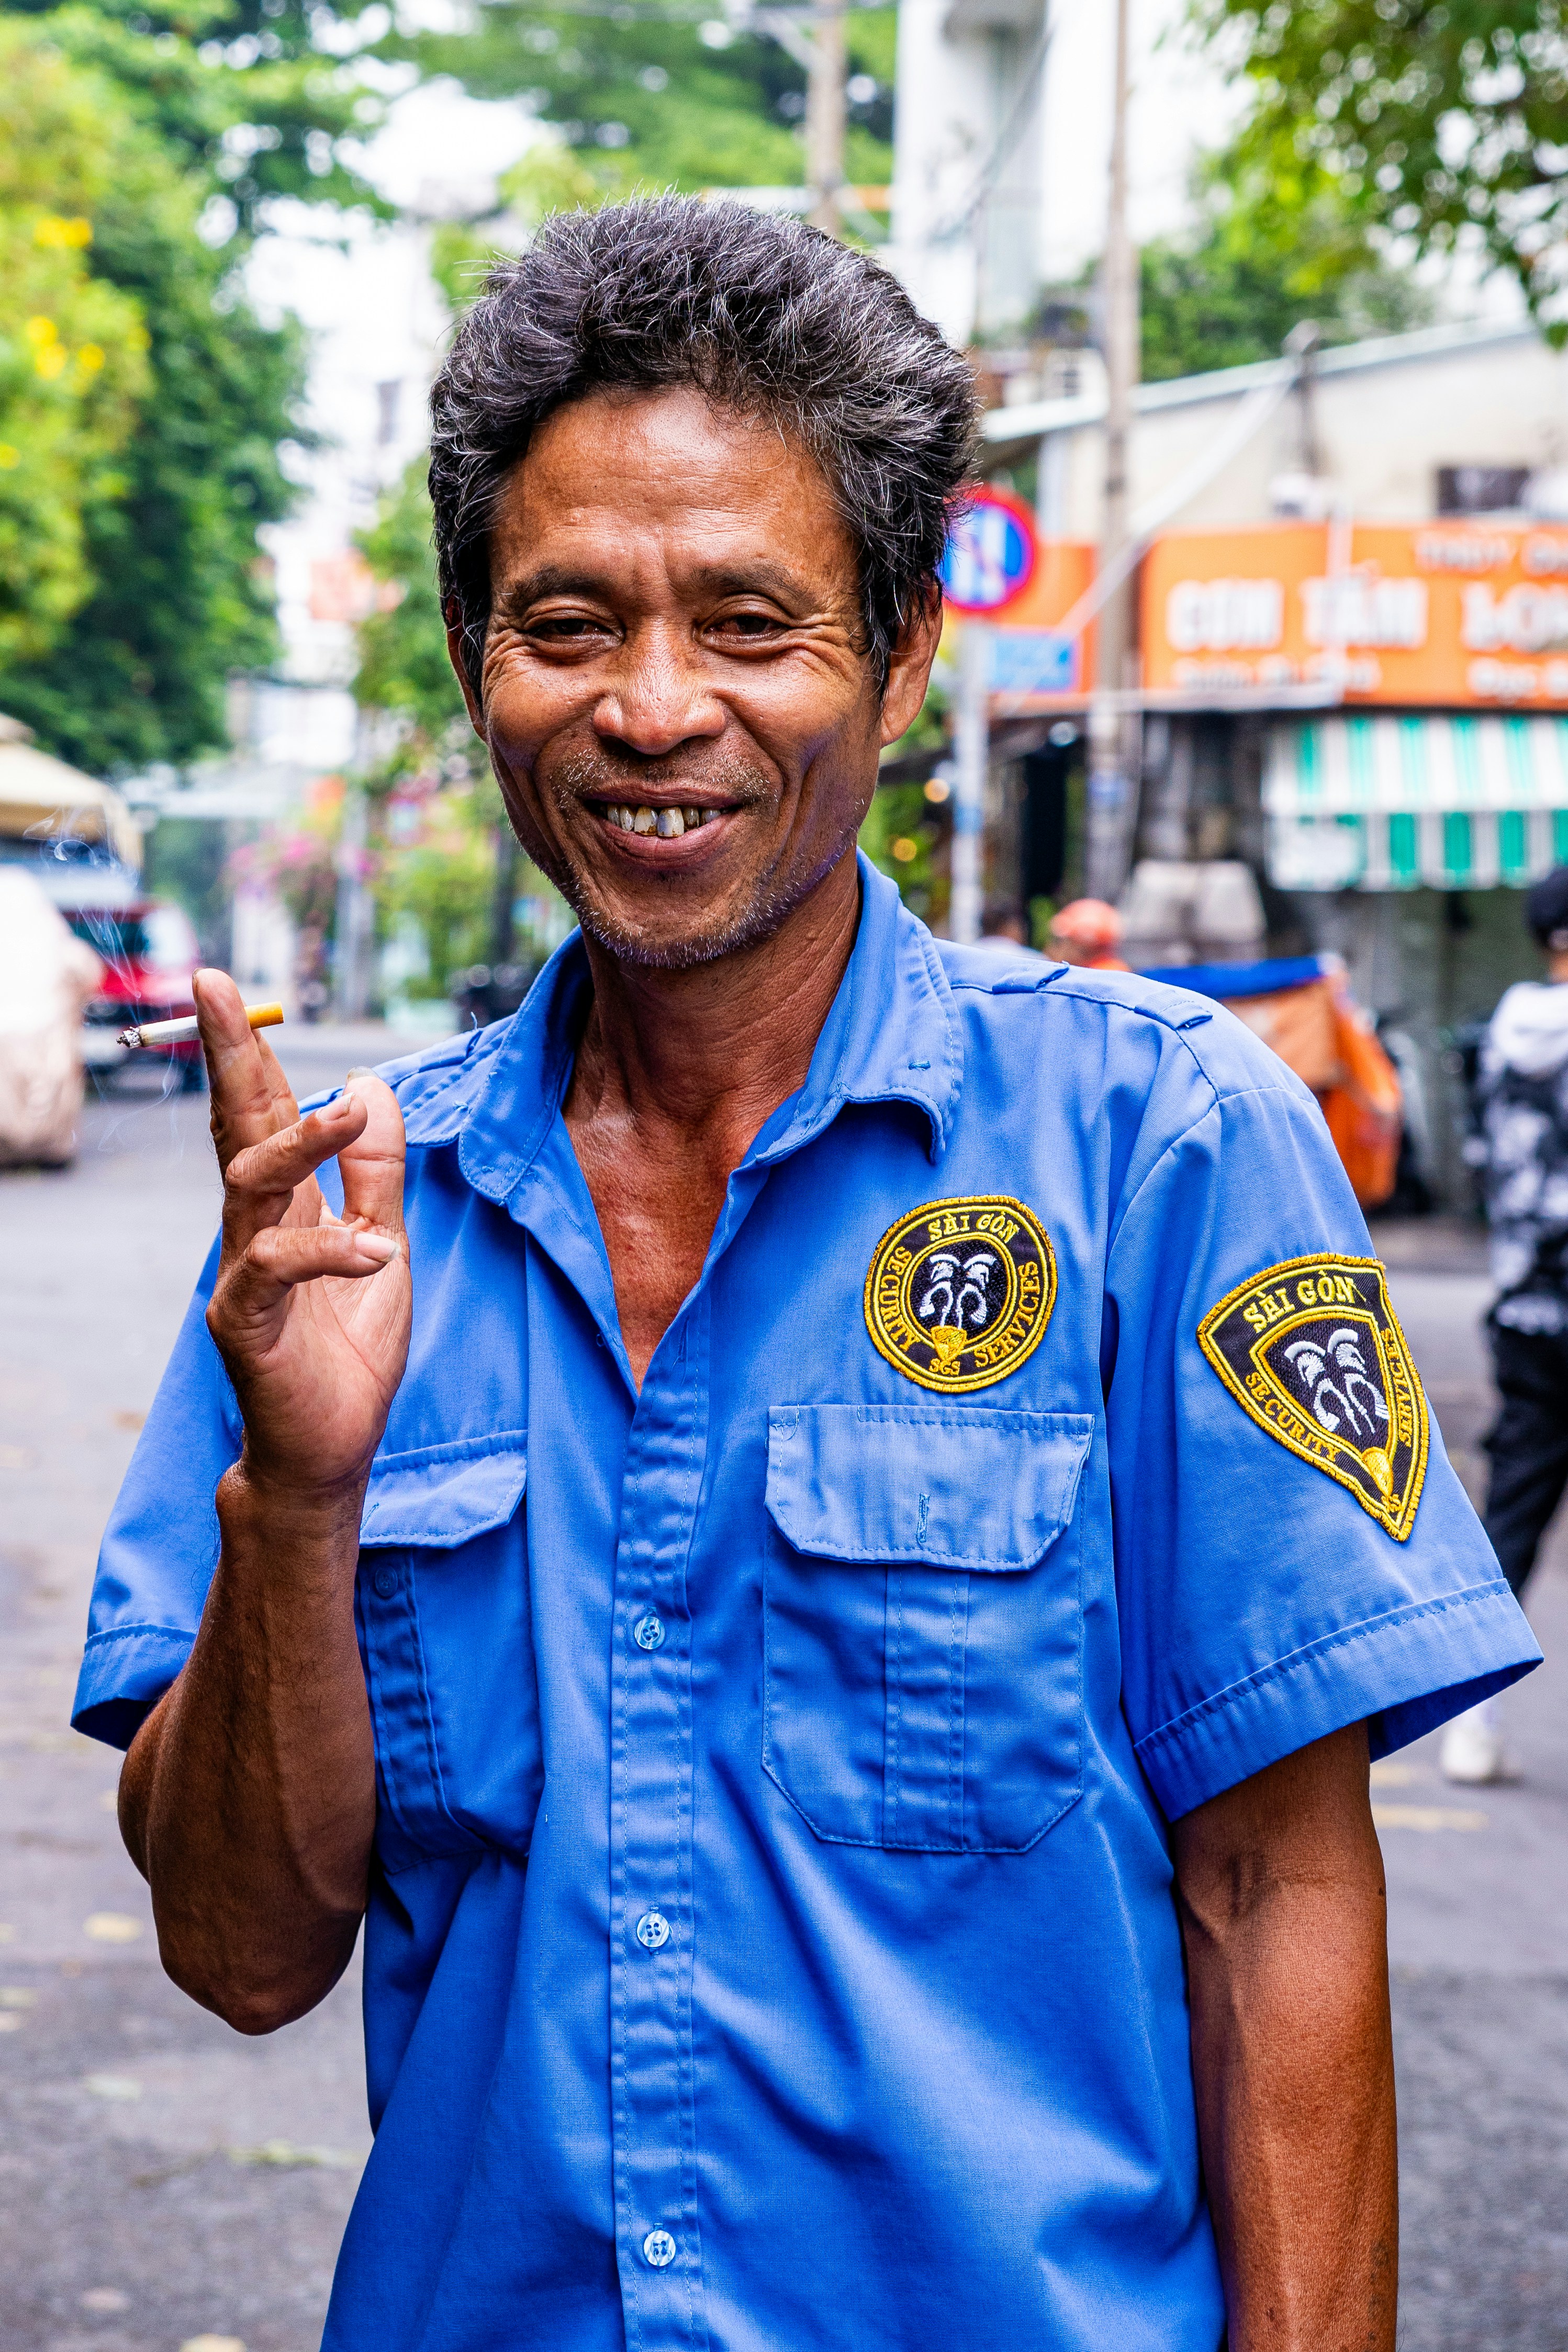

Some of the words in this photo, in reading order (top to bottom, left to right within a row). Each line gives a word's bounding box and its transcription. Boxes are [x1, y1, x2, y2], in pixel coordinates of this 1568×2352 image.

[928, 1212, 970, 1241] SÀI
[879, 1246, 920, 1352] SECURITY
[974, 1261, 1040, 1367] SERVICES
[1243, 1287, 1295, 1333] SÀI
[1297, 1270, 1356, 1306] GÒN
[929, 1358, 960, 1375] SGS
[1381, 1328, 1413, 1447] SERVICES
[1246, 1372, 1341, 1461] SECURITY
